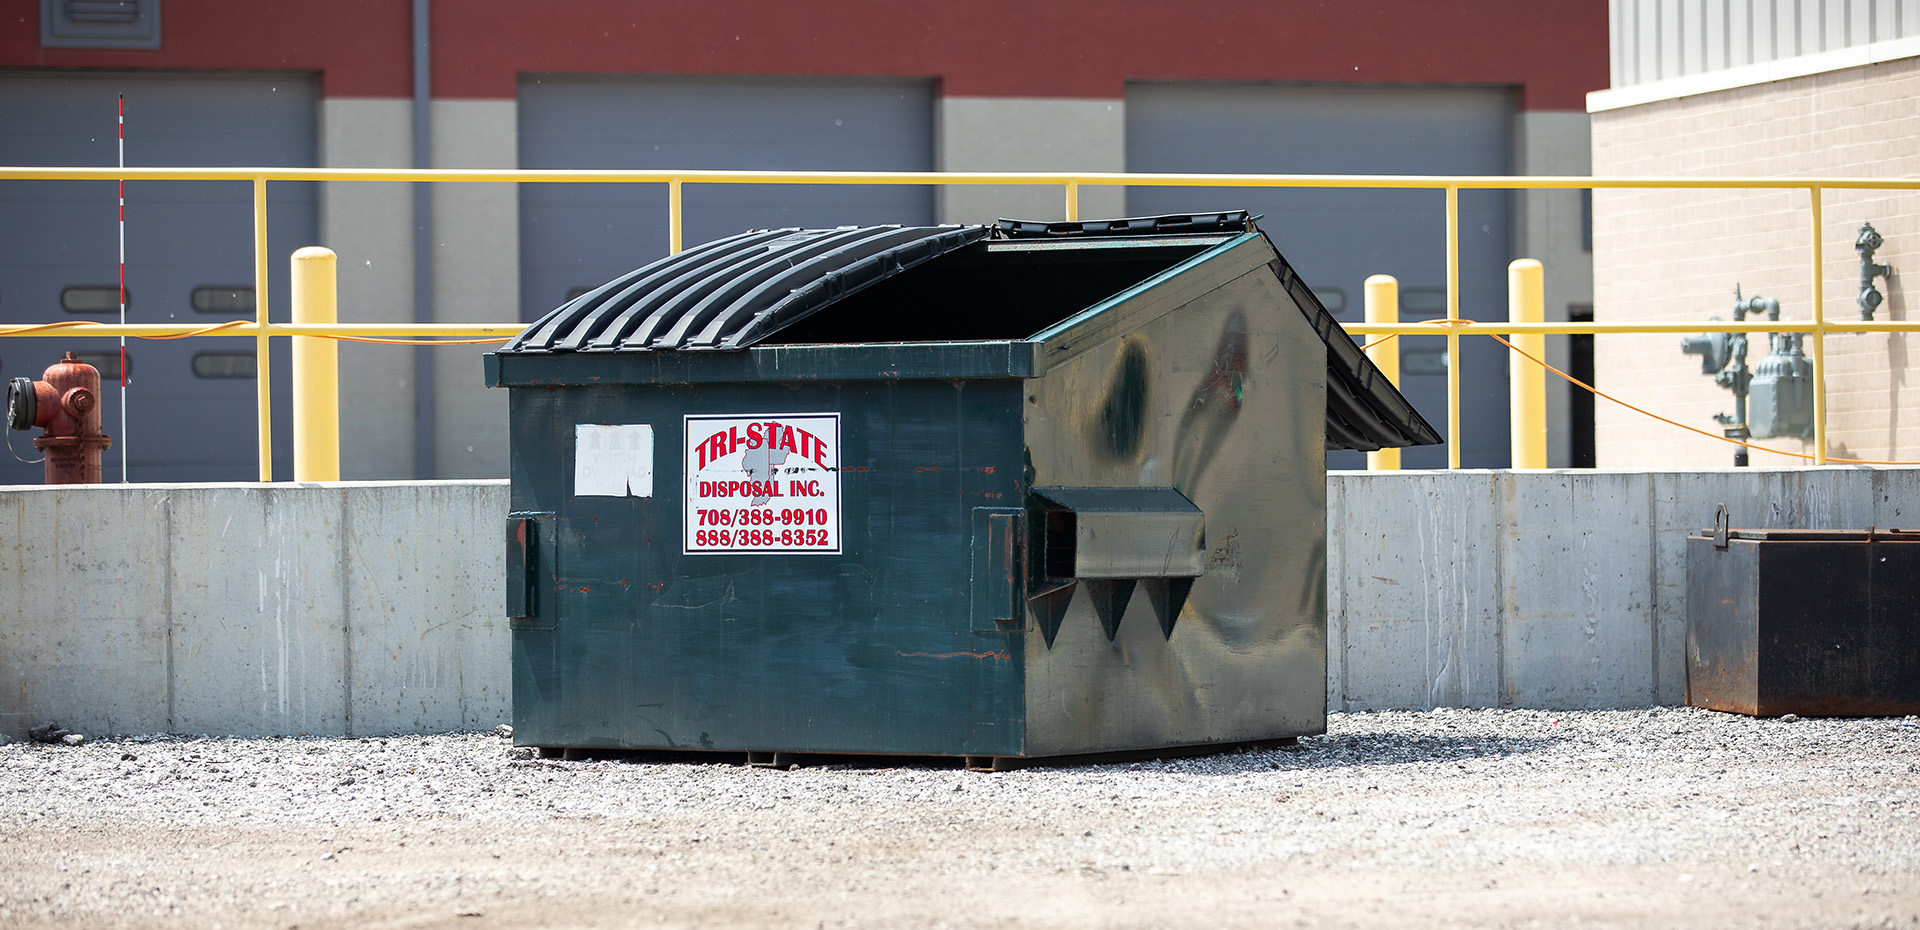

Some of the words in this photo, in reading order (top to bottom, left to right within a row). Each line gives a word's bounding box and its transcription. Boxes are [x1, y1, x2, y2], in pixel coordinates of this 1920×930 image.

[695, 422, 828, 471] TRI-STATE
[699, 480, 784, 498] DISPOSAL
[790, 480, 825, 497] INC.
[697, 508, 828, 528] 708/388-9910
[695, 529, 829, 548] 888/388-8352
